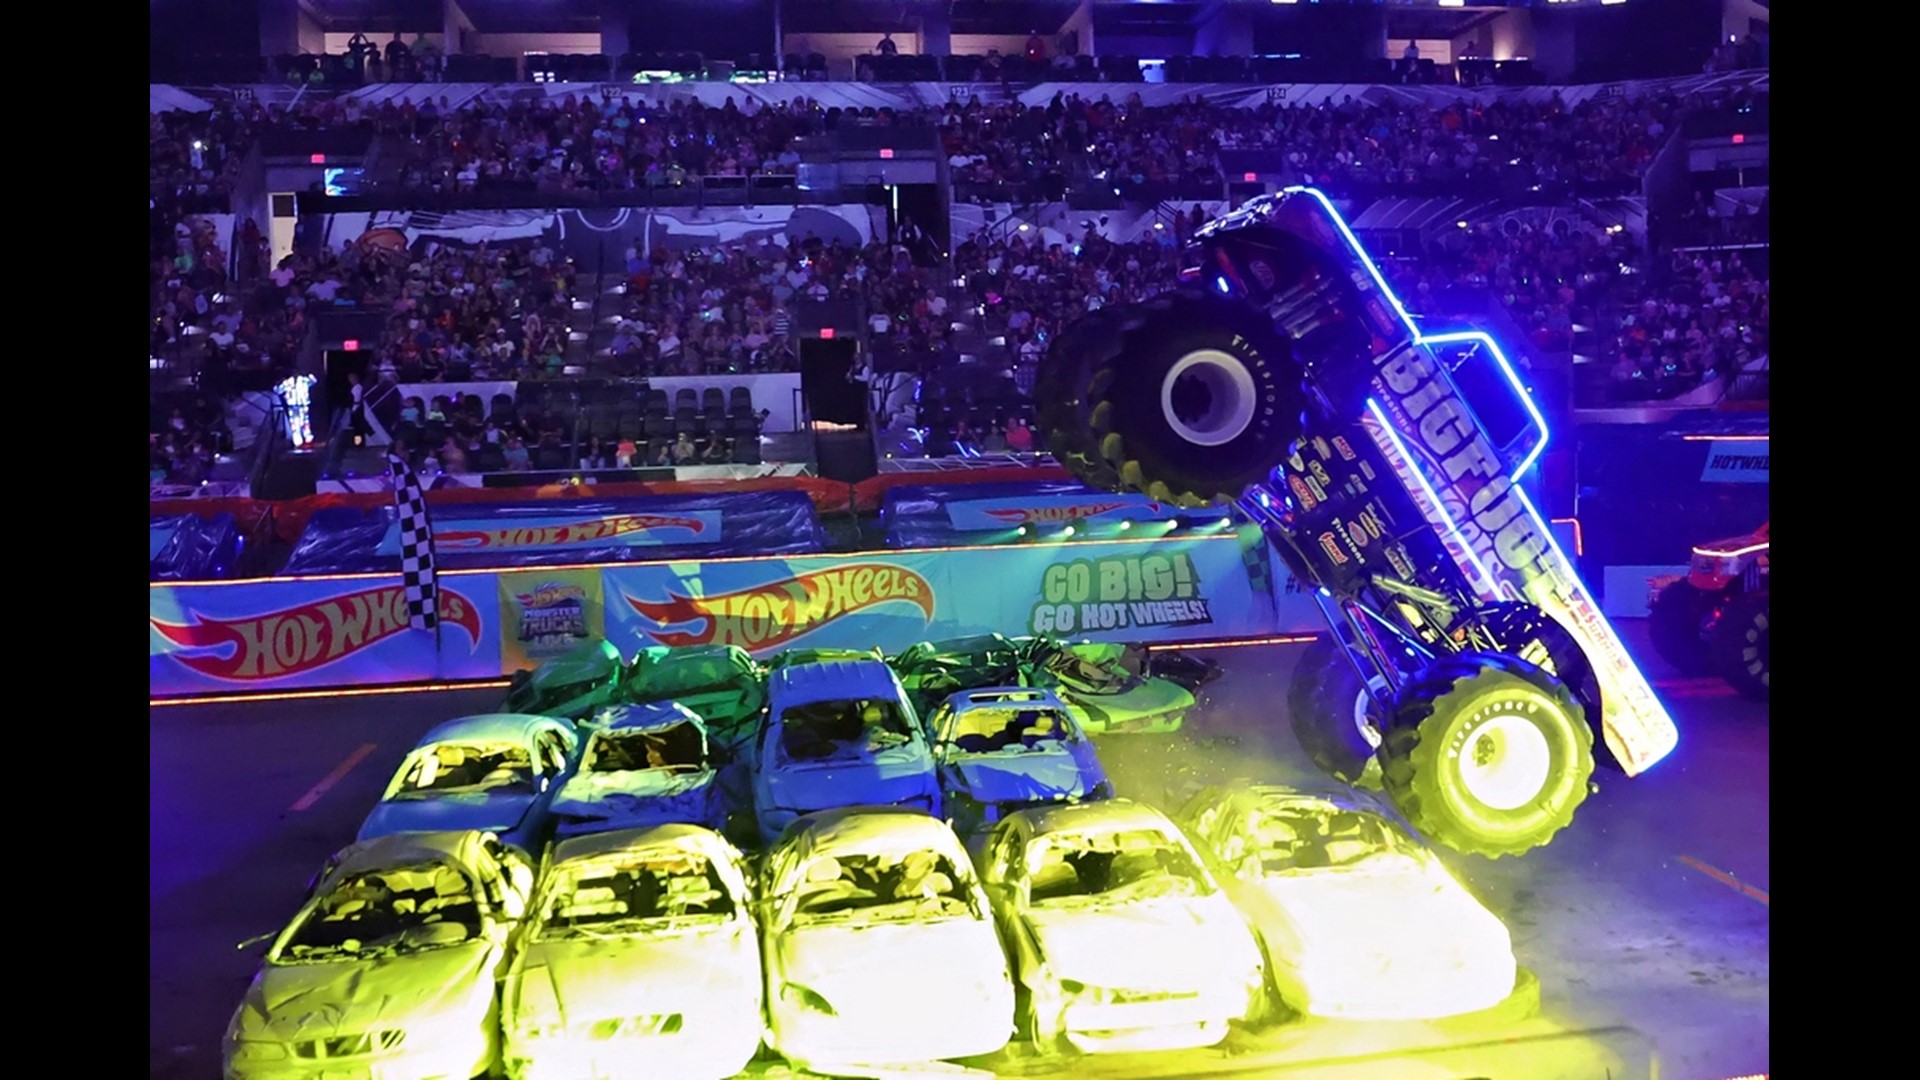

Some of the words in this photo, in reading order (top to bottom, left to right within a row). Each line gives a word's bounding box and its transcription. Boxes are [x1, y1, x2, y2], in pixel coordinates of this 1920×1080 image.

[233, 89, 252, 101] 121
[951, 86, 969, 97] 123
[1371, 375, 1412, 433] Firestone
[1379, 344, 1575, 606] BIGFOOT
[1331, 517, 1366, 565] Firestone
[1045, 563, 1090, 603] GO
[1100, 554, 1193, 601] BIG!
[697, 592, 789, 648] HOT
[1033, 603, 1075, 634] GO
[1081, 602, 1128, 630] HOT
[1129, 600, 1208, 625] WHEELS!
[220, 613, 325, 677] HOT
[1447, 700, 1525, 759] Firestone
